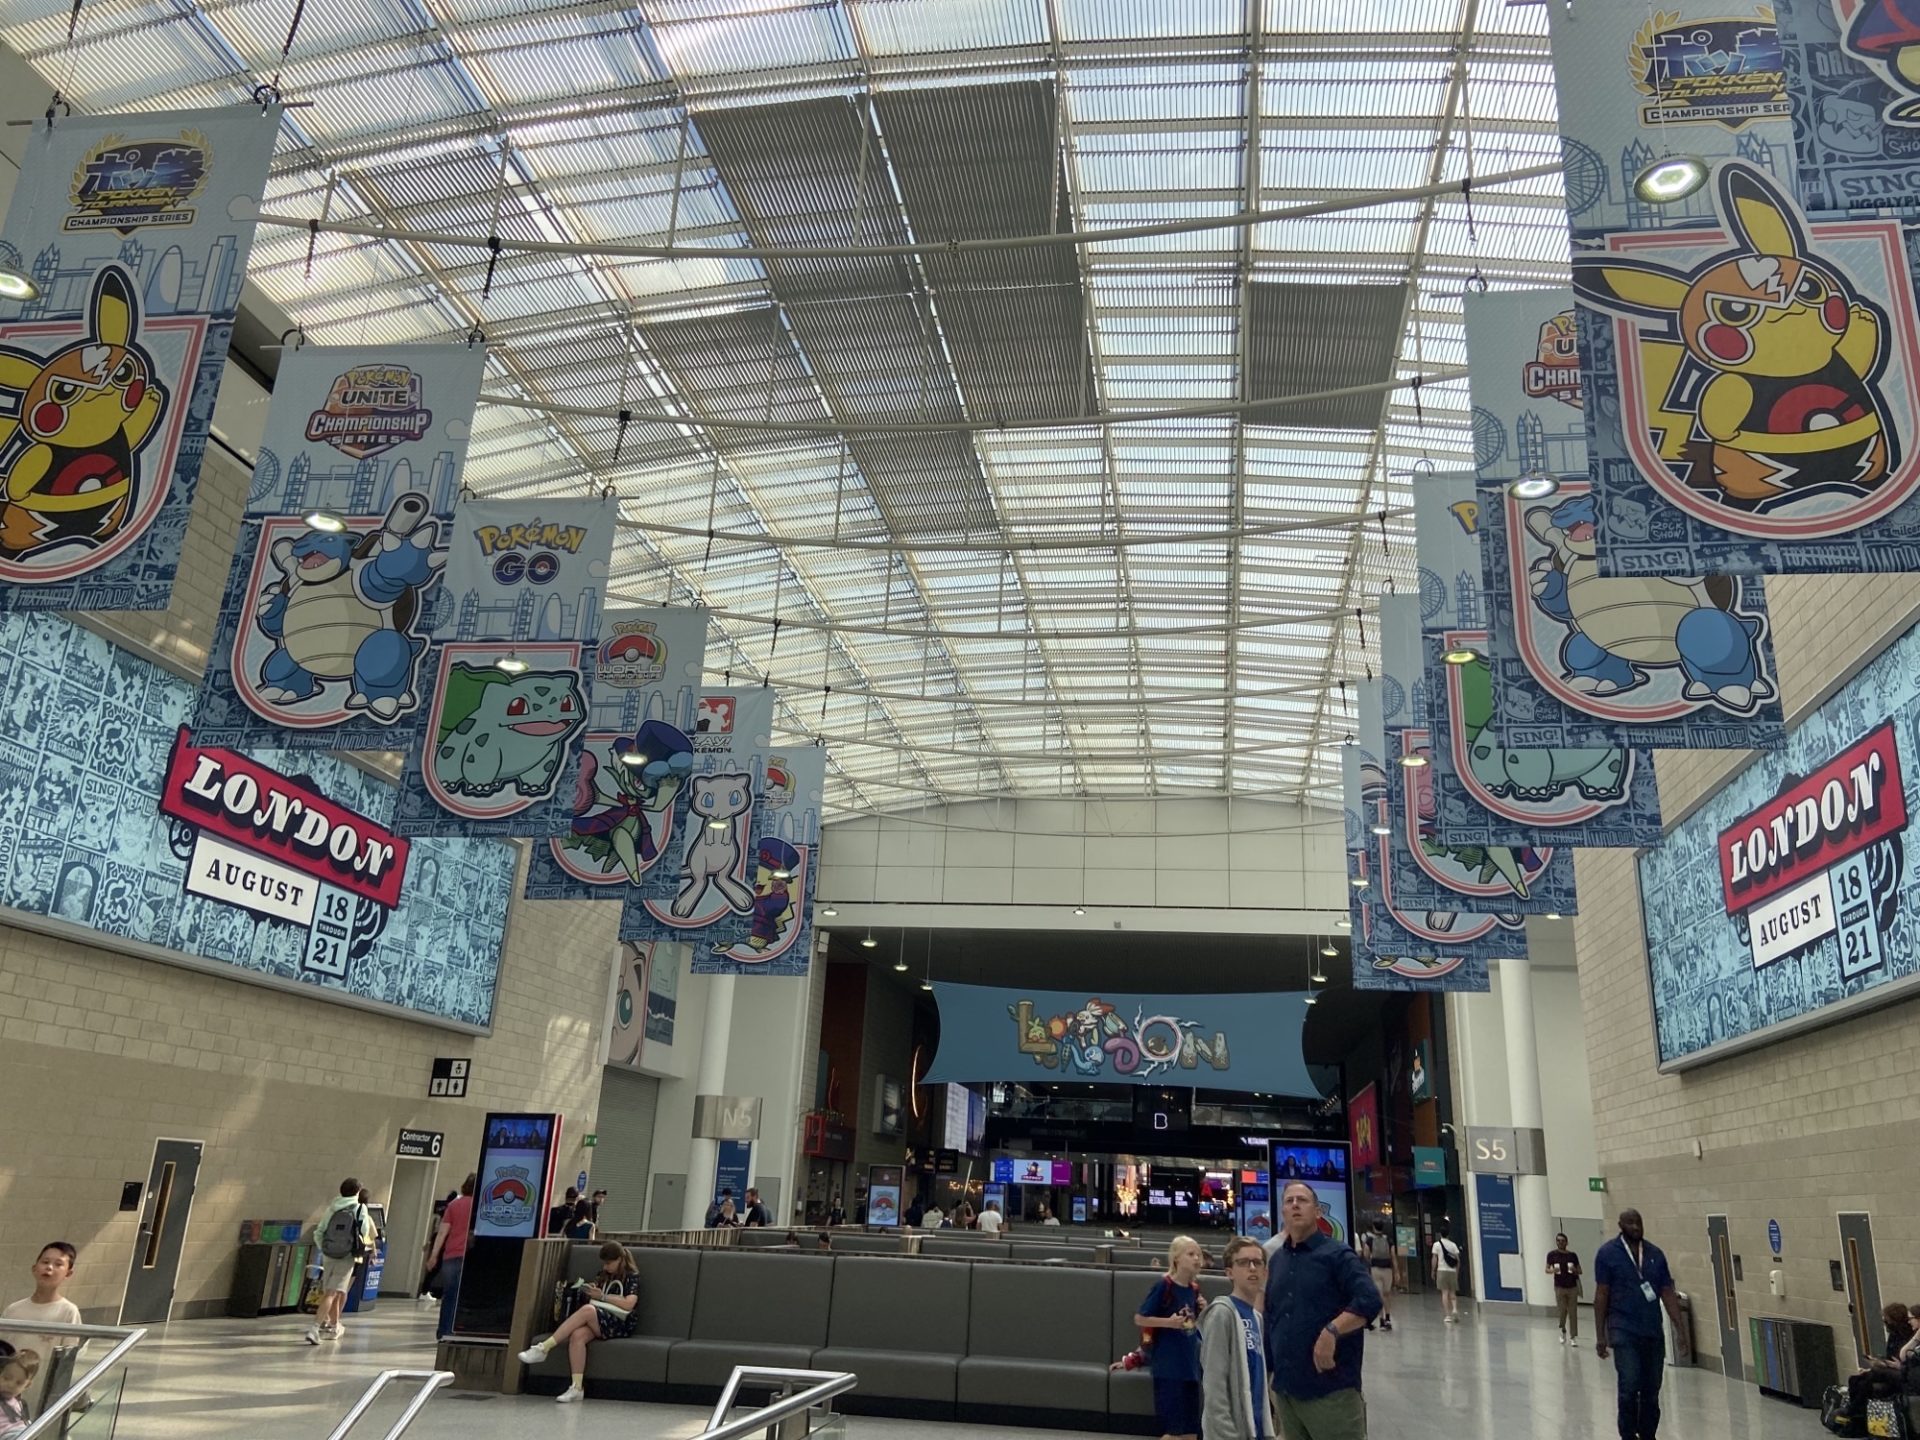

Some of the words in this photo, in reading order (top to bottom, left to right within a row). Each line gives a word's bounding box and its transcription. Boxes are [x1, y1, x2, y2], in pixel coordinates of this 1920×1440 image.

[1659, 84, 1785, 98] TOURNAMEN
[1650, 104, 1759, 119] CHAMPIONSHIP
[1763, 103, 1791, 113] SER
[70, 215, 149, 227] CHAMPIONSHIP
[151, 213, 190, 223] SERIES
[341, 390, 408, 405] UNITE
[331, 434, 401, 445] SERIES
[492, 551, 560, 585] GO
[1620, 549, 1686, 570] SING!
[597, 664, 662, 673] WORLD
[102, 701, 139, 726] PONYTA
[201, 731, 238, 745] SING!
[694, 735, 733, 747] LAY!
[1512, 729, 1560, 744] SING!
[85, 778, 119, 797] SING!
[184, 755, 394, 877] LONDON
[1730, 750, 1881, 884] LONDON
[1449, 831, 1485, 843] SING!
[206, 858, 304, 907] AUGUST
[1838, 863, 1861, 906] 18
[323, 893, 349, 922] 18
[1841, 906, 1868, 923] THROUGH
[1760, 893, 1822, 947] AUGUST
[319, 922, 346, 938] THROUGH
[312, 938, 340, 967] 21
[1845, 924, 1873, 966] 21
[723, 1108, 752, 1128] N5
[402, 1131, 431, 1142] Contractor
[431, 1134, 442, 1155] 6
[400, 1144, 424, 1154] Entrance
[1476, 1138, 1507, 1161] S5
[369, 1271, 381, 1279] FREE
